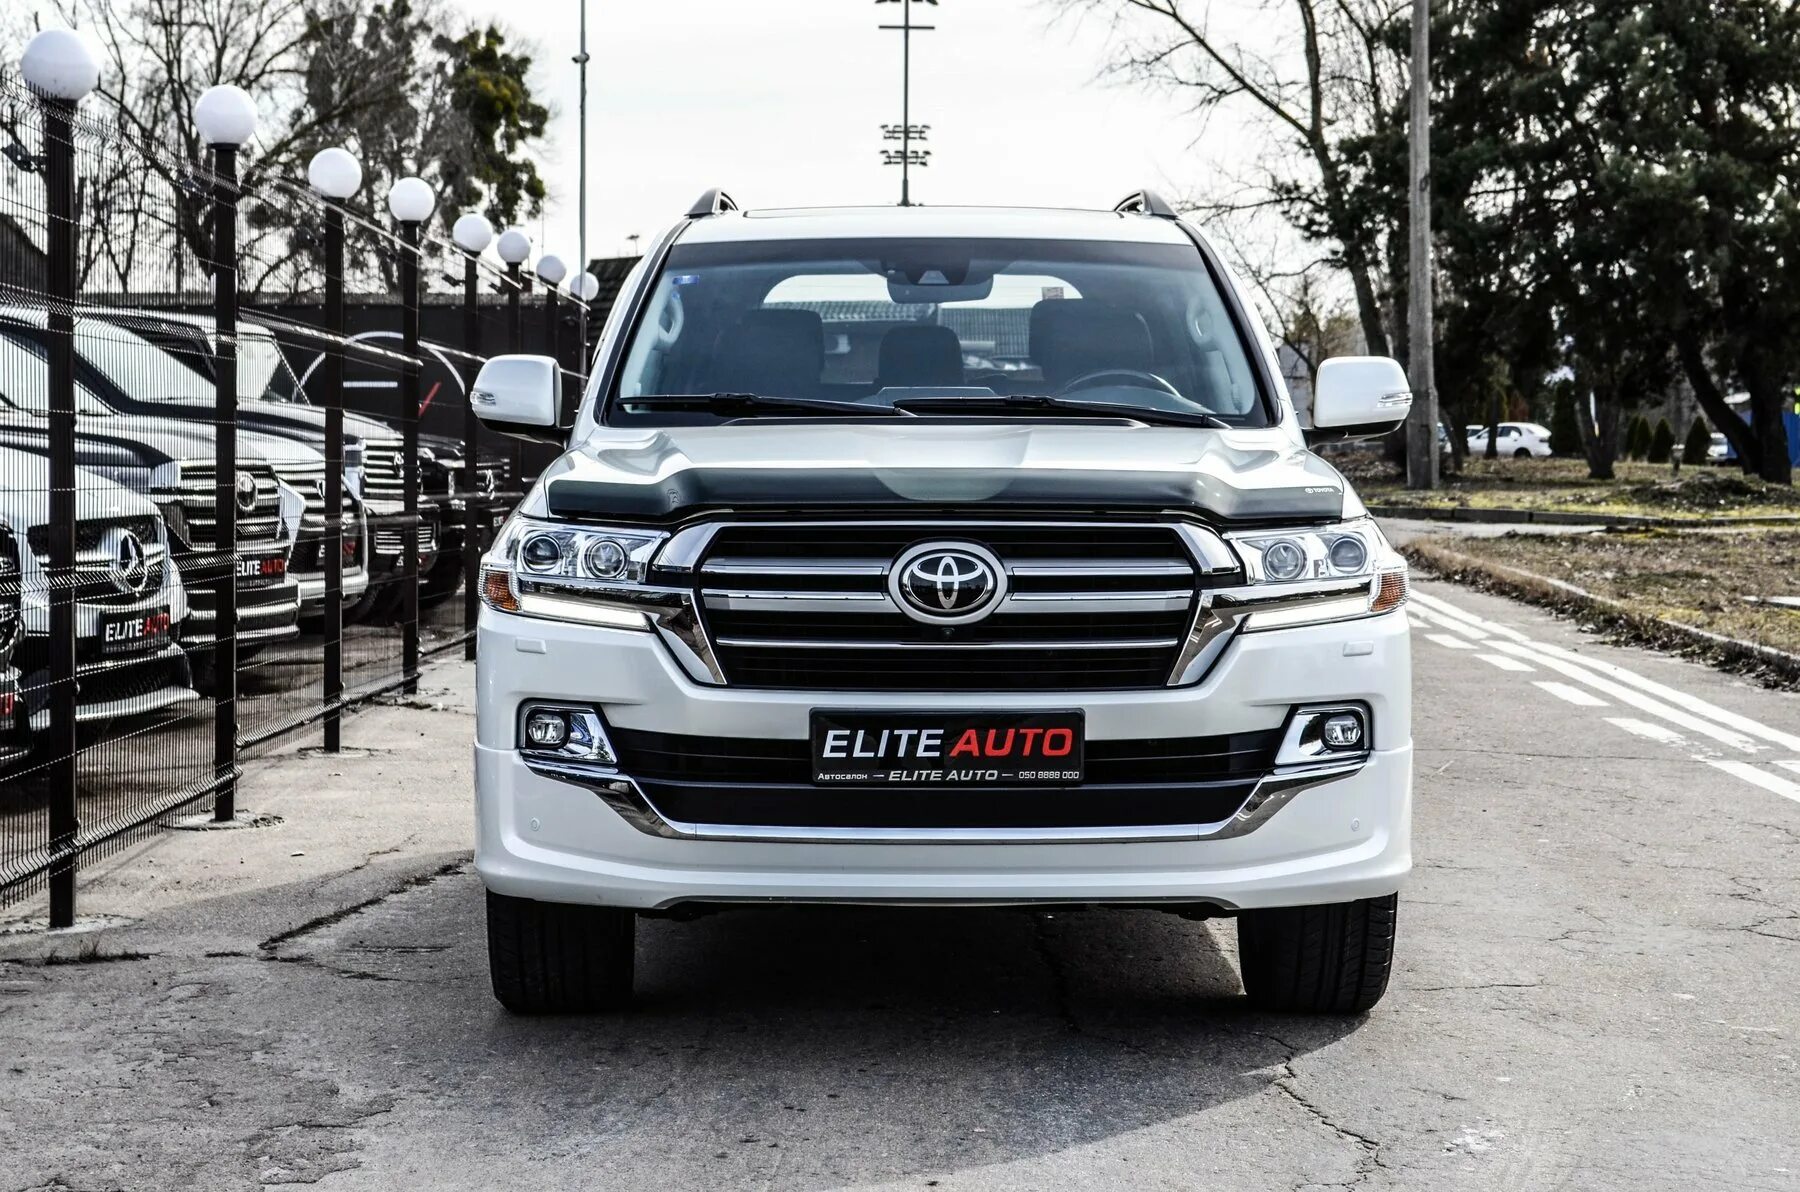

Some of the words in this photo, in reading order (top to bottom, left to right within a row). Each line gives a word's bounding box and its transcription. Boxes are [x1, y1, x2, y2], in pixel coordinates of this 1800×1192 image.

[236, 560, 261, 577] ELITE
[105, 618, 144, 642] ELITE
[822, 728, 945, 758] ELITE
[949, 728, 1074, 757] AUTO
[817, 772, 868, 781] Автосалон
[888, 770, 944, 781] ELITE
[945, 770, 999, 781] AUTO
[1018, 771, 1036, 779] 050
[1036, 771, 1061, 779] 8888
[1061, 771, 1080, 779] 000
